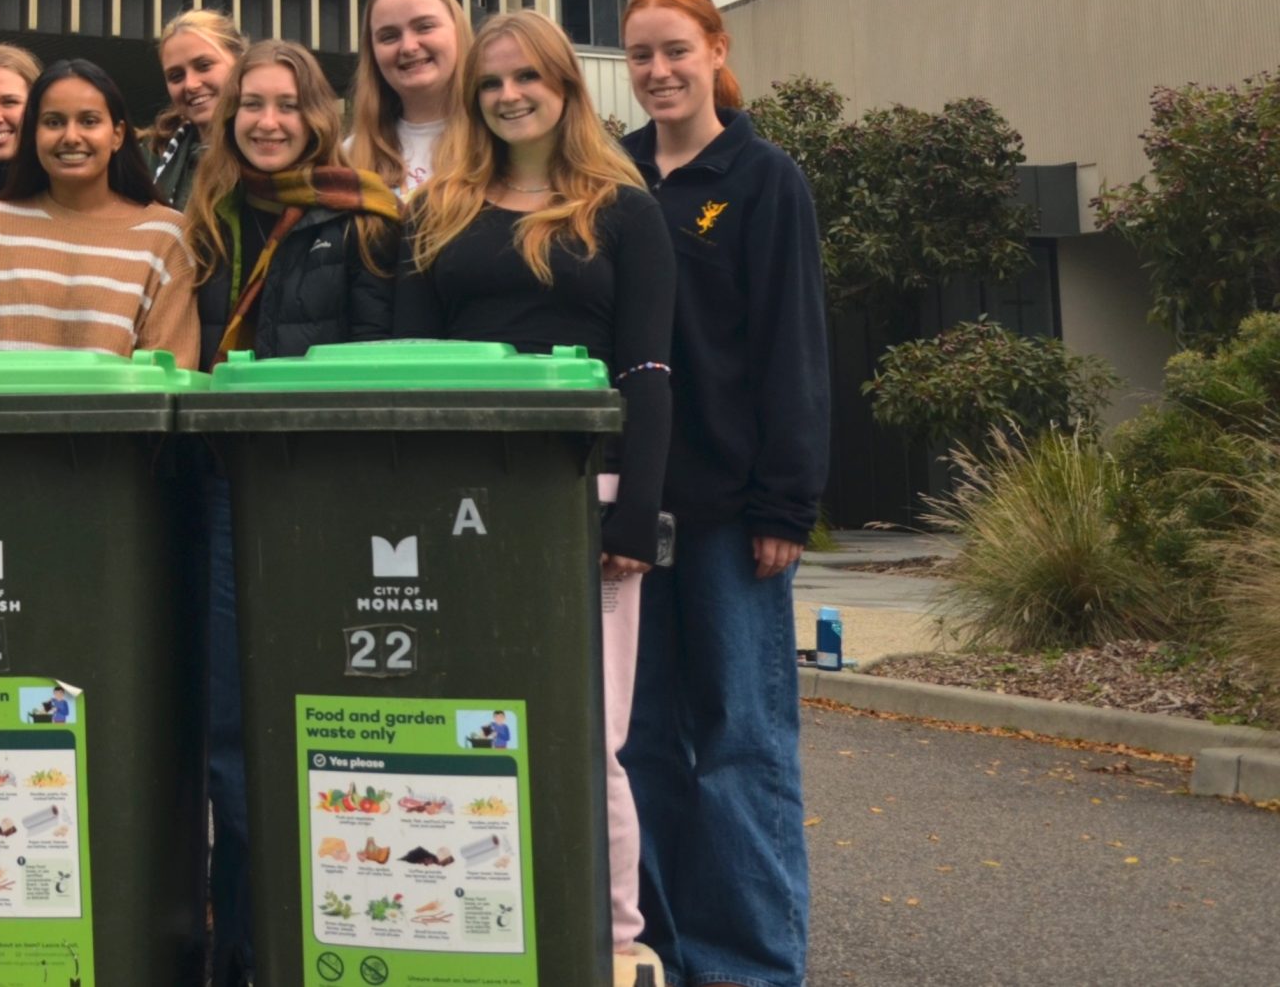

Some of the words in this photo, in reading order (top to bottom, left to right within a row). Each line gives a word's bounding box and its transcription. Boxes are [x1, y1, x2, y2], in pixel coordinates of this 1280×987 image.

[451, 498, 488, 535] A
[373, 586, 401, 596] CITY
[403, 586, 421, 597] OF
[356, 598, 439, 612] MONASH
[350, 629, 413, 669] 22
[305, 707, 345, 722] Food
[349, 709, 380, 723] and
[385, 710, 446, 727] garden
[306, 726, 356, 739] waste
[360, 726, 396, 744] only
[329, 756, 348, 767] Yes
[349, 757, 385, 769] please
